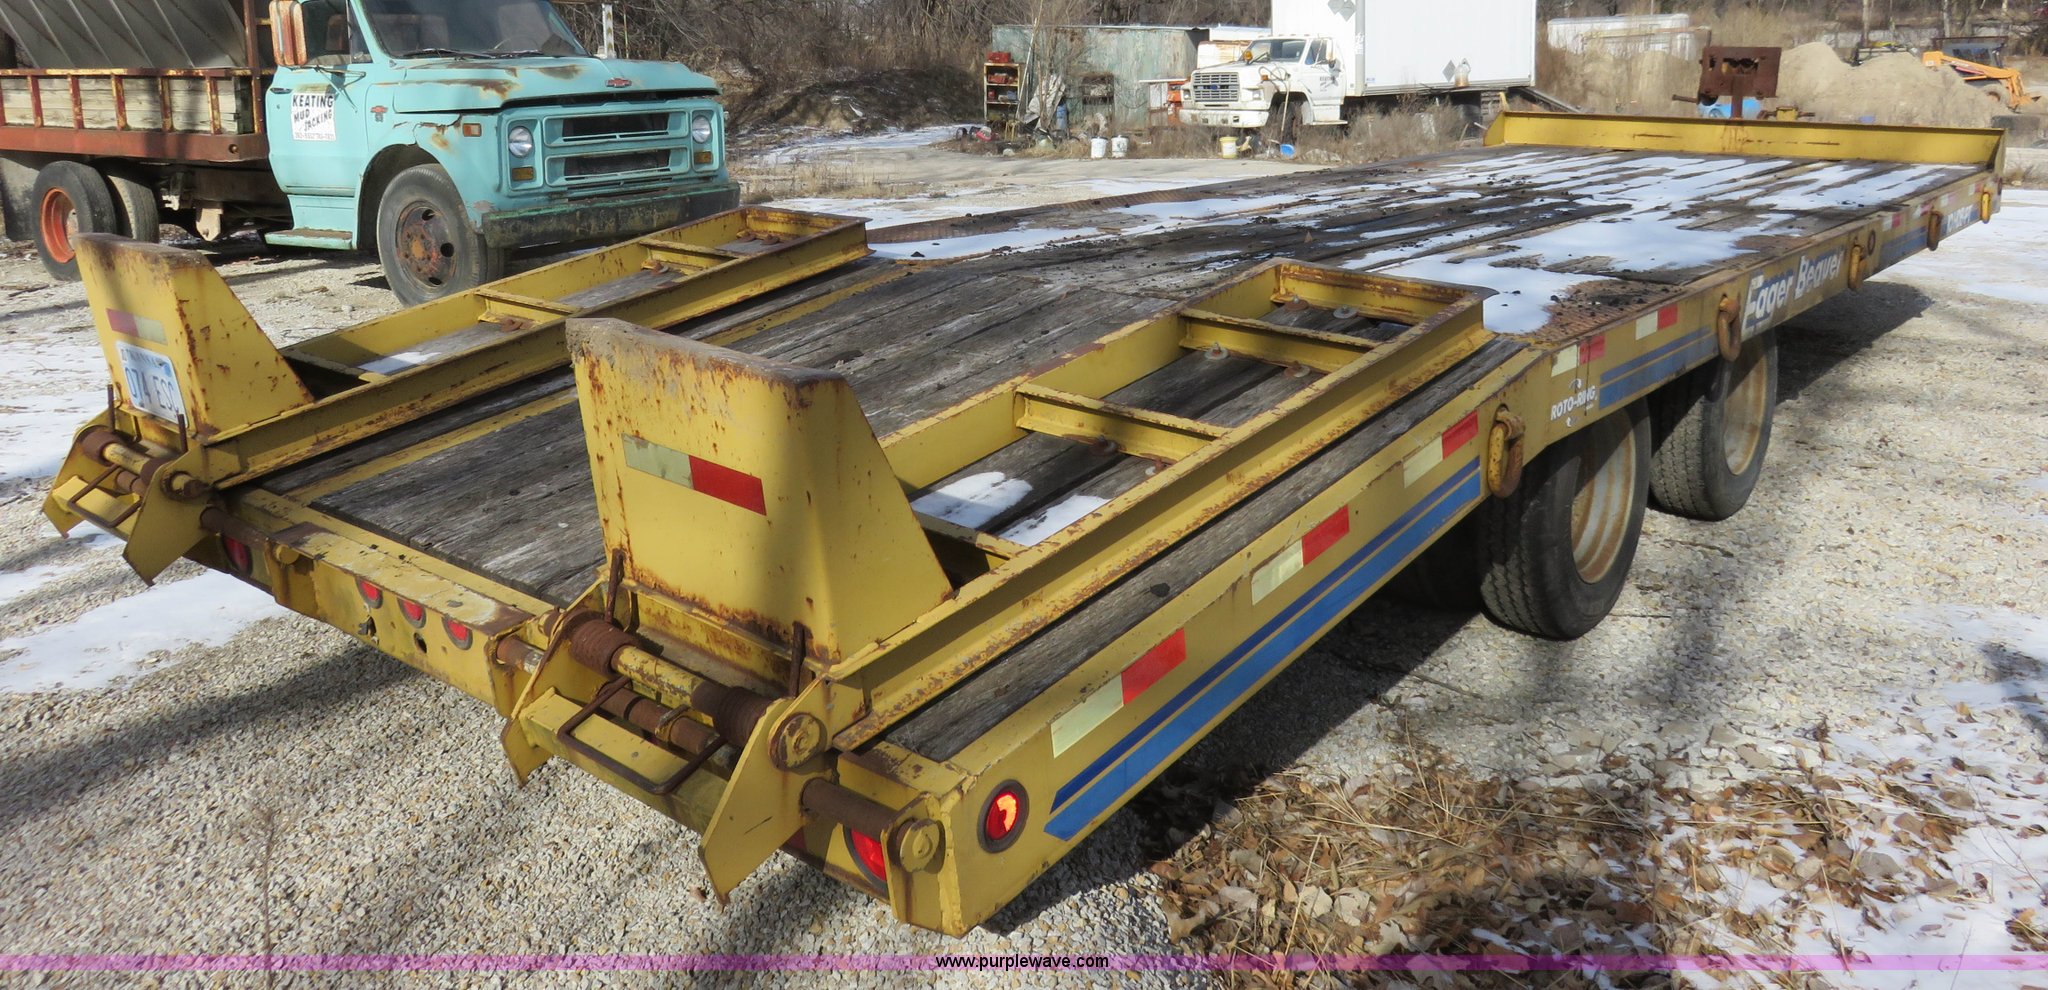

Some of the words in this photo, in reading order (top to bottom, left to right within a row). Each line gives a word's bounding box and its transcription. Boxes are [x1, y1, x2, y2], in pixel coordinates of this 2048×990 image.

[293, 94, 334, 108] KEATING
[293, 108, 310, 123] MUD
[1550, 385, 1596, 421] ROTO-RING
